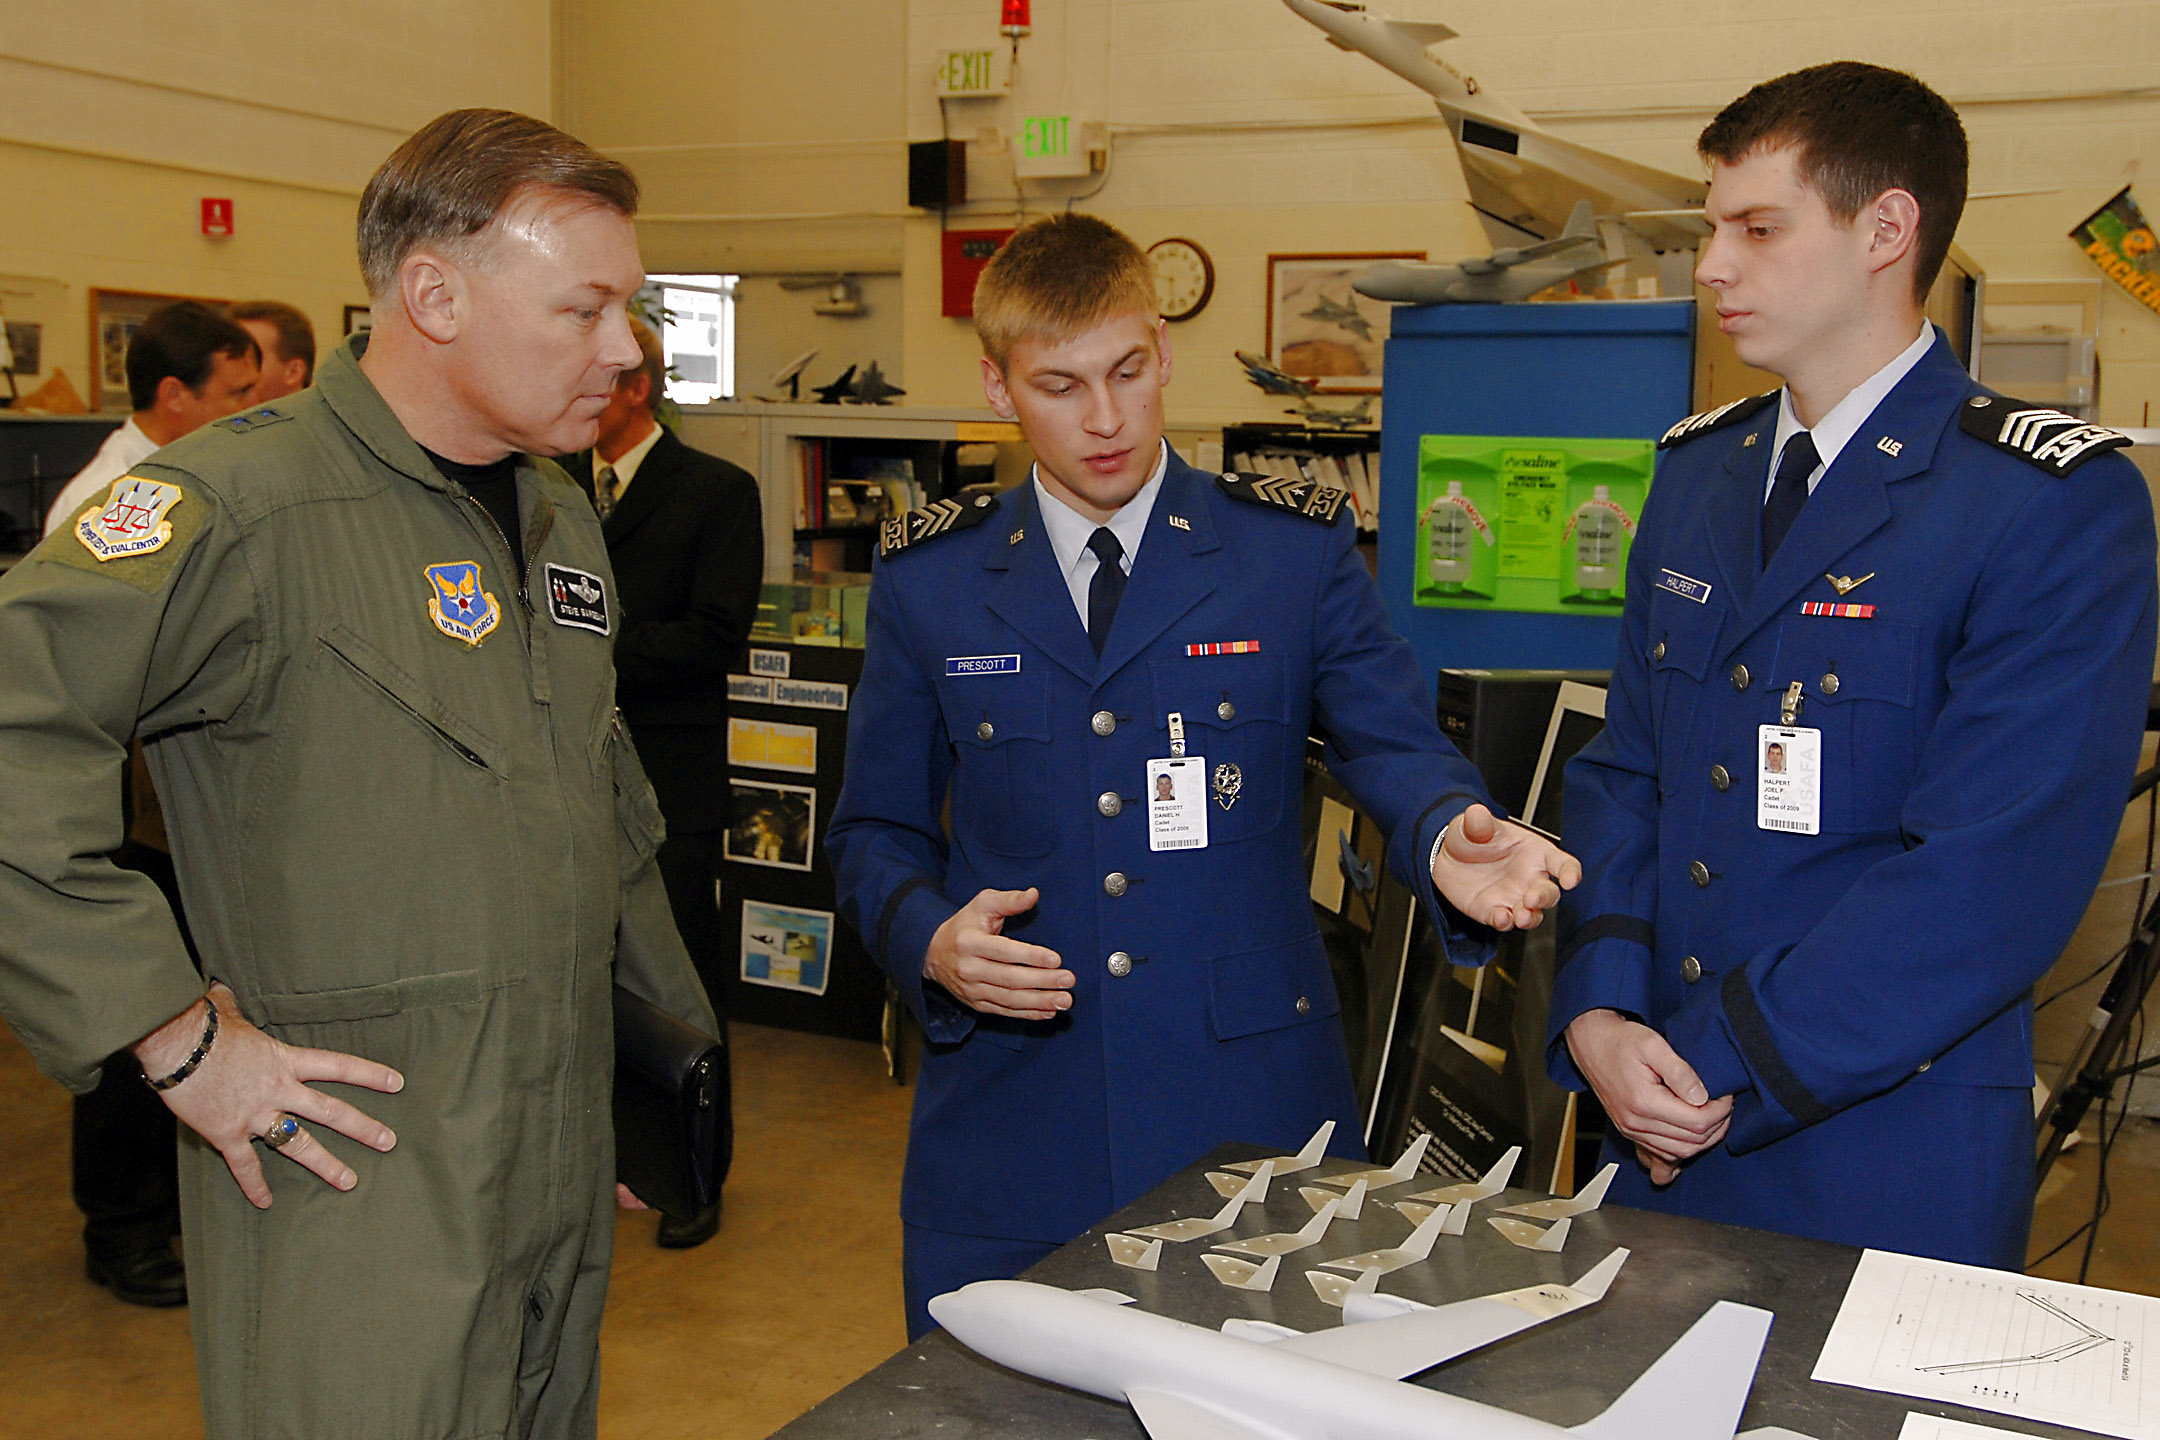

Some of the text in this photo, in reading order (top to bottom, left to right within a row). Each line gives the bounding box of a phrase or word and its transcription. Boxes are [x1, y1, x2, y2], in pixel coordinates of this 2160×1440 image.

[949, 51, 993, 90] EXIT
[1025, 116, 1069, 157] EXIT
[1876, 436, 1903, 458] US
[1168, 515, 1191, 531] US
[1666, 576, 1697, 594] HALPERT
[441, 613, 495, 638] US AIR FORCE
[957, 659, 1006, 671] PRESCOTT
[777, 683, 844, 707] Engineering
[1763, 794, 1780, 802] Cadet
[1763, 802, 1779, 811] Class
